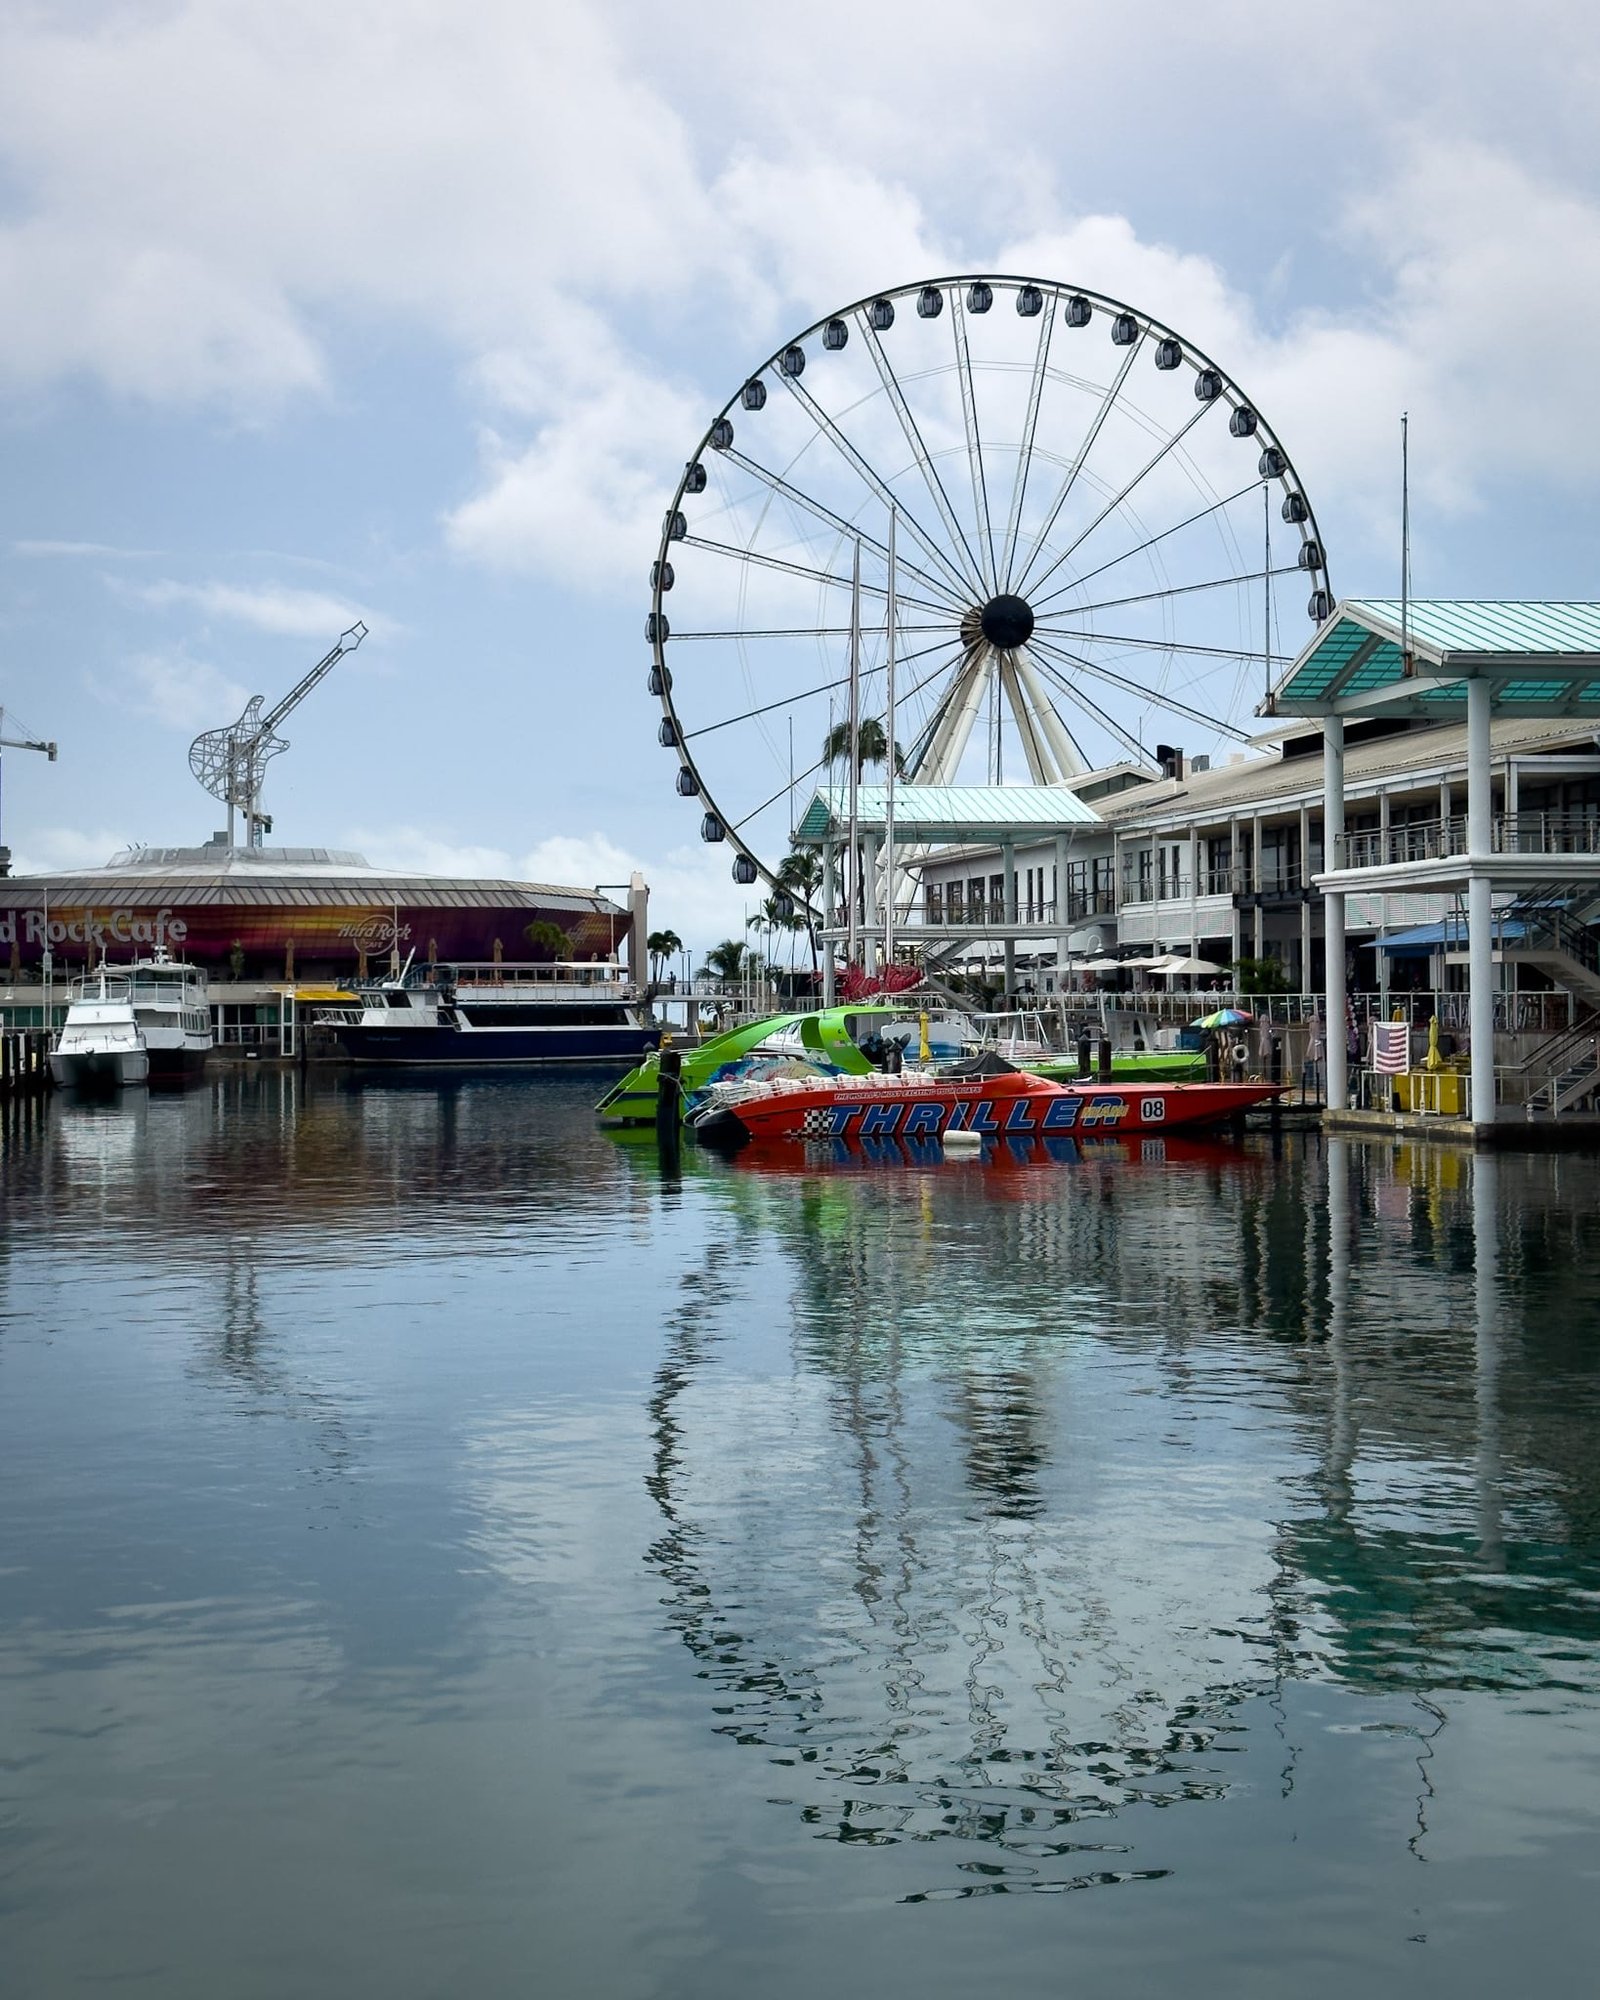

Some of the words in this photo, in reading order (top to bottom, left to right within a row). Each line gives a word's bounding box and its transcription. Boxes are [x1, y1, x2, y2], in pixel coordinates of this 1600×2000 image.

[22, 910, 107, 949] Rock
[110, 909, 187, 947] Cafe
[338, 923, 377, 937] Hard
[376, 923, 411, 940] Rock
[828, 1096, 1124, 1134] THRILLER
[1080, 1104, 1130, 1119] MIAMI
[1143, 1101, 1163, 1118] 08
